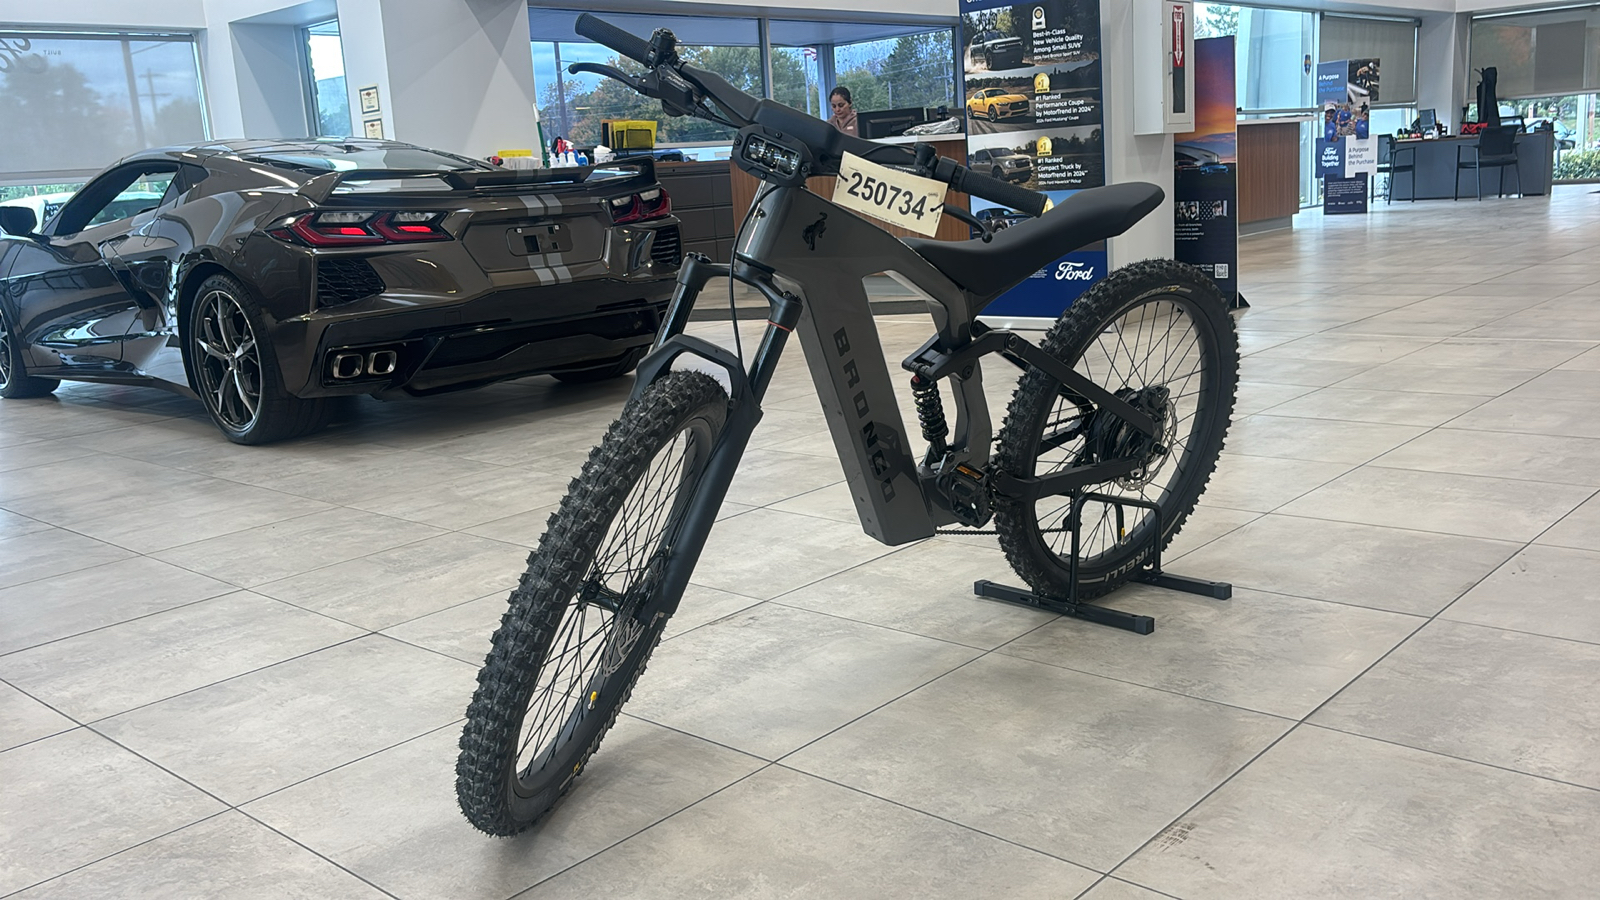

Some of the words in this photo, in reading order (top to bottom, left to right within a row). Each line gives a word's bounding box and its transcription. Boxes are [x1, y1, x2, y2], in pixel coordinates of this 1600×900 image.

[1032, 28, 1066, 38] Best-in-Class
[847, 172, 927, 220] 250734
[1055, 261, 1094, 280] Ford
[833, 327, 896, 503] BRONCO
